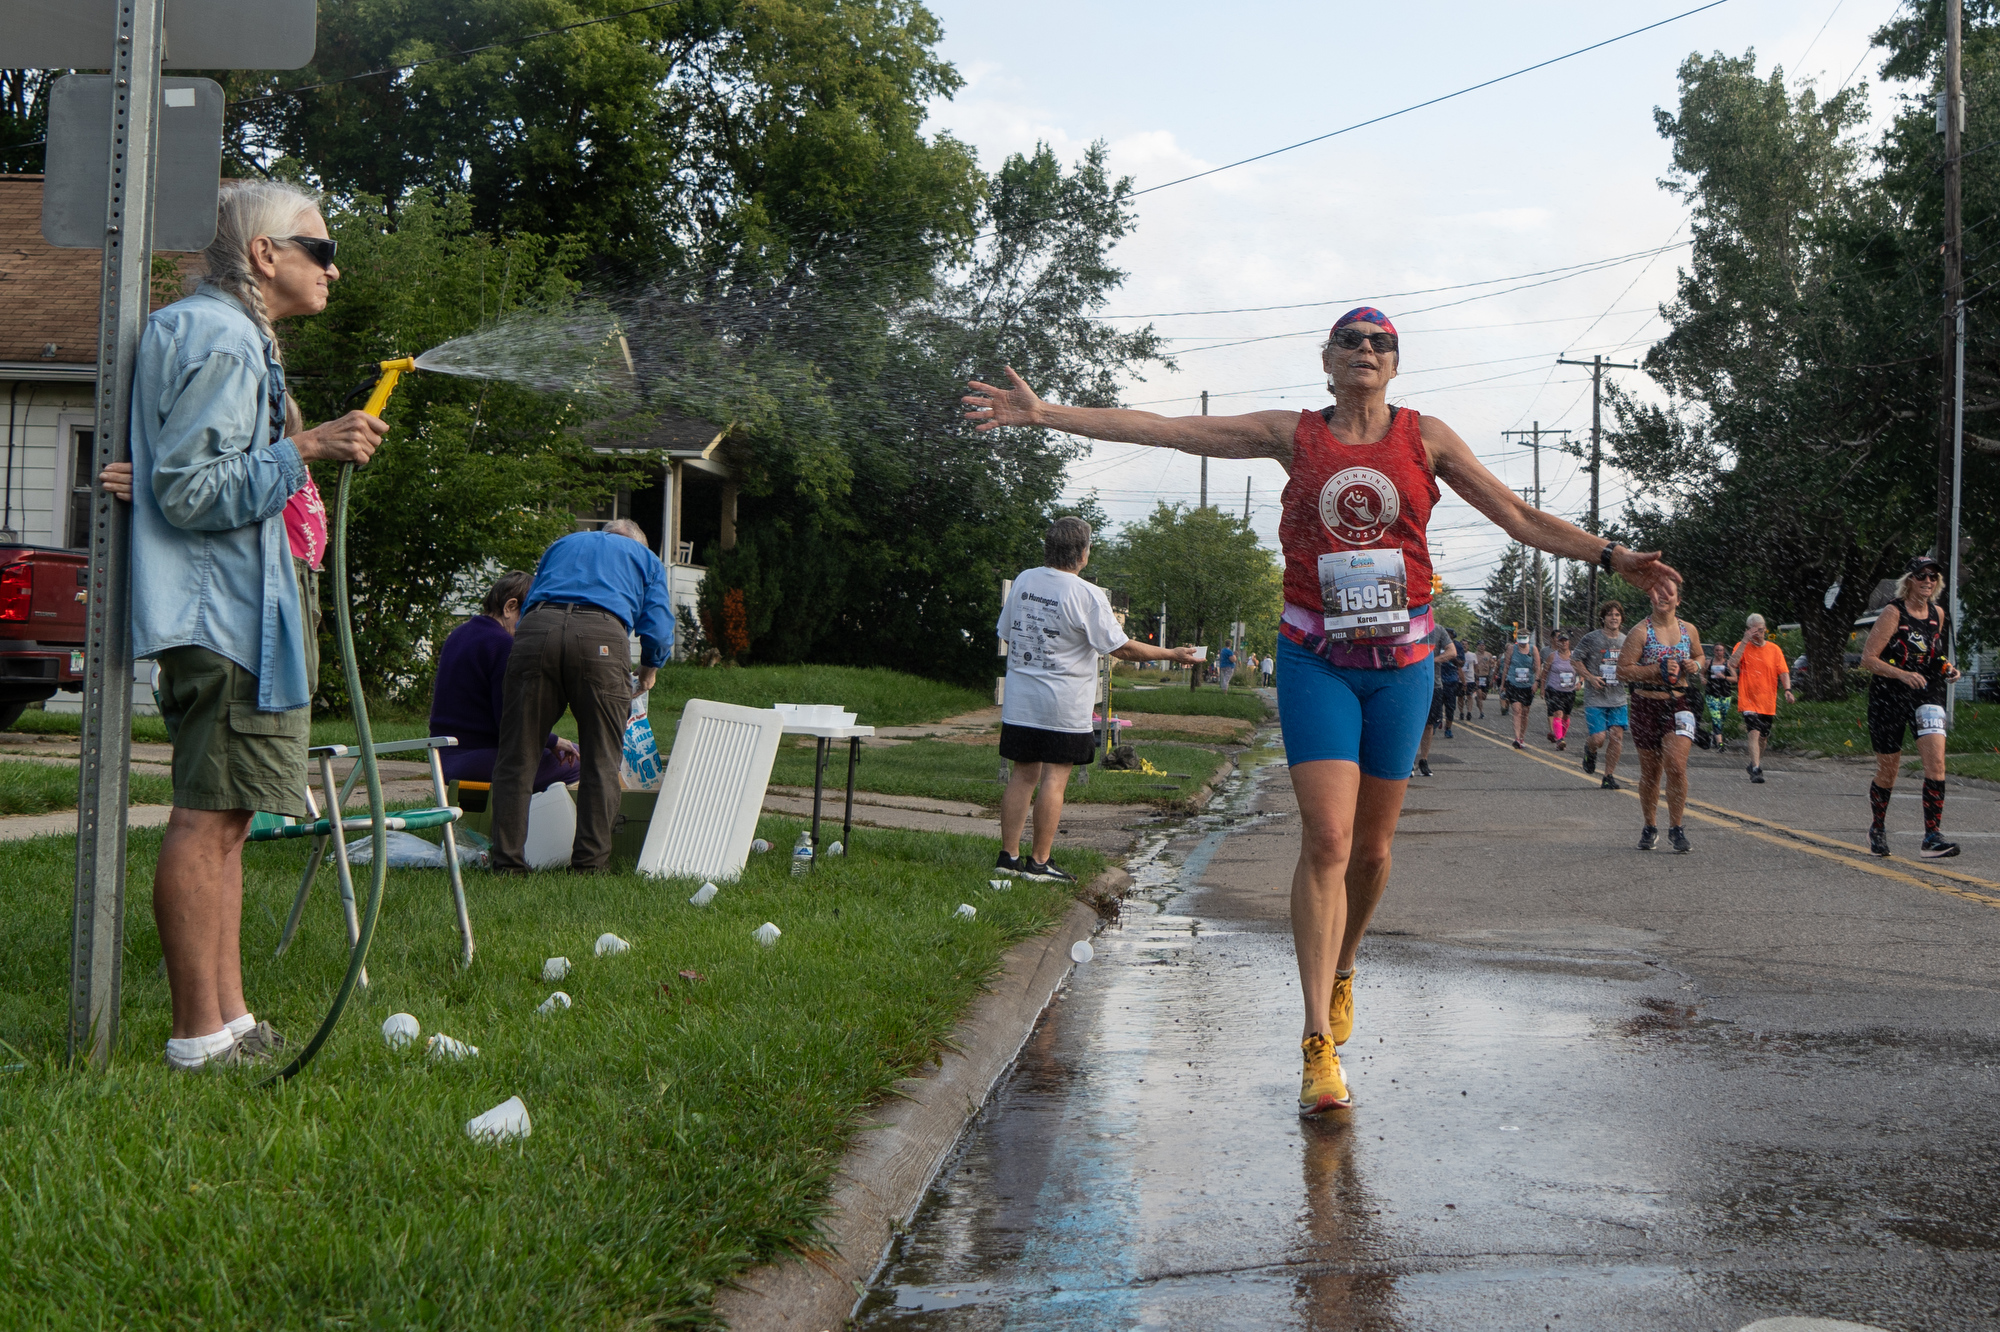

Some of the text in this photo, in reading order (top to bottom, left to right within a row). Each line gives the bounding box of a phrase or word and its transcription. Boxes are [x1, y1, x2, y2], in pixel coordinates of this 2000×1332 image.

[1326, 490, 1334, 521] TEAM
[1336, 473, 1388, 491] RUNNING
[1347, 528, 1377, 539] 2023
[1029, 592, 1058, 606] Huntington
[1336, 583, 1393, 612] 1595
[1357, 615, 1378, 624] Karen
[1922, 718, 1944, 728] 3149
